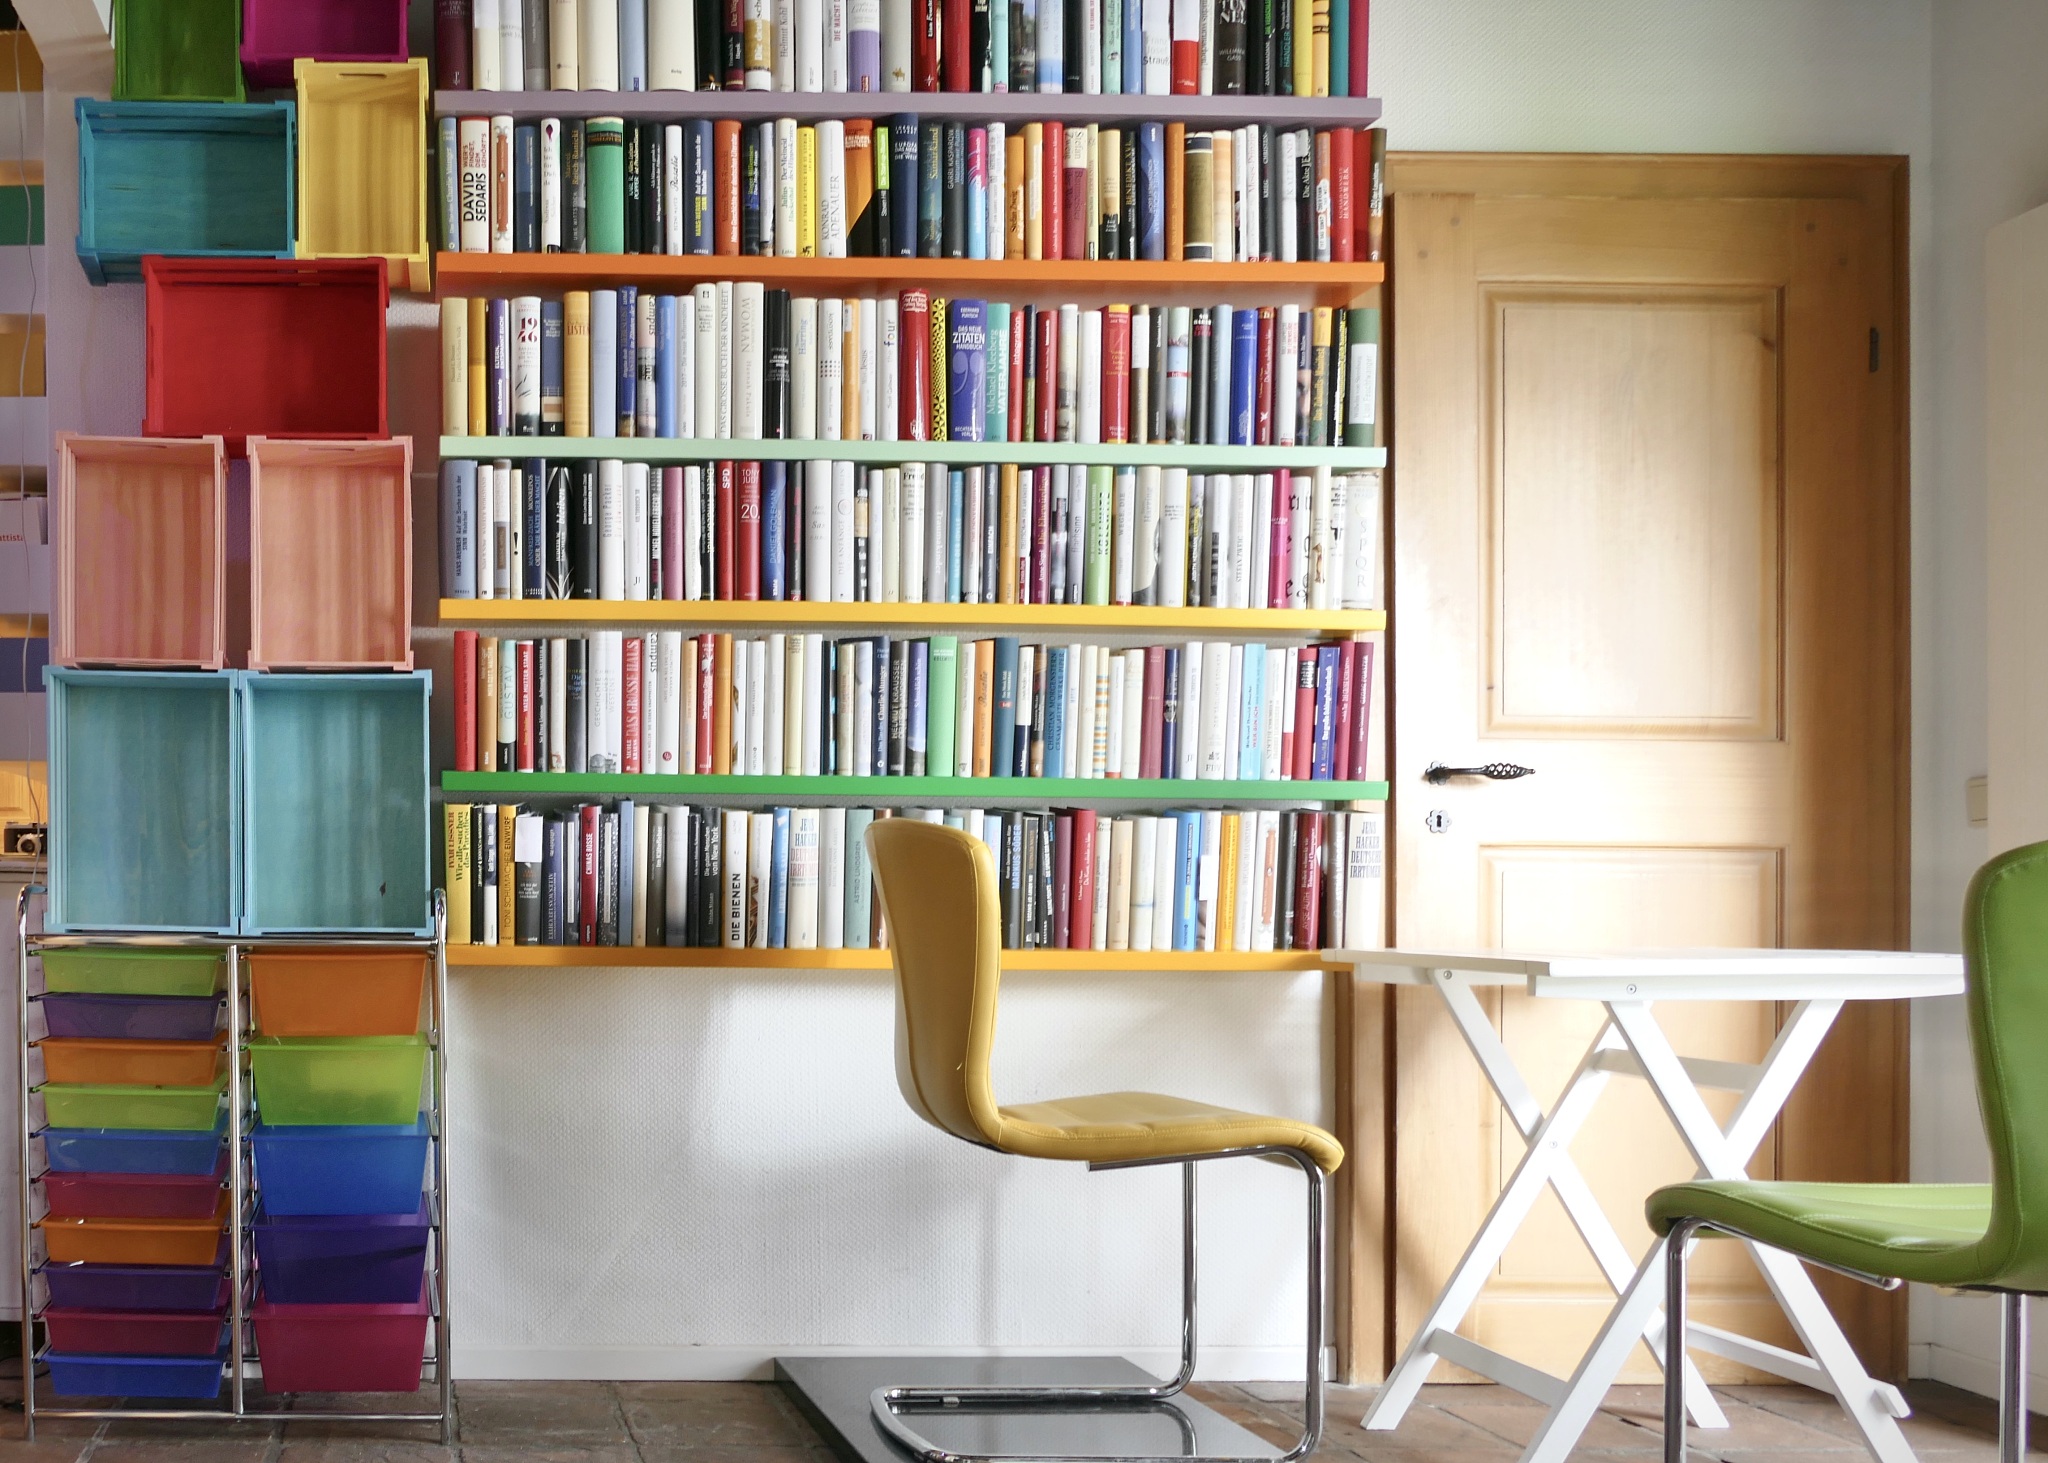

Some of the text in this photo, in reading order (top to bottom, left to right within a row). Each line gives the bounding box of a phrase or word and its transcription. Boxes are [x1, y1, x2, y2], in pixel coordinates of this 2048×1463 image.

[781, 7, 789, 57] Helmut Kohl
[833, 4, 841, 41] DIE MACHT
[753, 43, 763, 60] Die
[570, 130, 580, 185] Reich-Ranicki
[780, 137, 788, 181] Der Meineid
[1063, 131, 1074, 159] Zweig
[1073, 130, 1085, 160] Stefan
[462, 172, 475, 221] DAVID
[476, 172, 487, 221] SEDARIS
[730, 132, 738, 243] Meine Geschichte der deutschen Literatur
[1125, 141, 1133, 206] BENEDIKT XVI.
[1301, 167, 1310, 184] Akte
[1302, 185, 1310, 199] Die
[821, 199, 831, 241] KONRAD
[830, 174, 841, 239] ADENAUER
[645, 296, 656, 336] campus
[680, 303, 688, 340] Reformation
[740, 297, 751, 353] WOMAN
[797, 319, 808, 355] Harring
[952, 332, 985, 344] ZITATEN
[1012, 316, 1021, 365] Integration
[719, 288, 730, 433] DAS GROSSE BUCH DER KINDHEIT
[860, 349, 868, 371] Jesus
[986, 329, 999, 414] Michael Kleeberg
[997, 328, 1008, 414] VATERJAHRE
[722, 468, 730, 489] SPD
[902, 472, 925, 482] Freud
[527, 473, 535, 567] MANFRED ZACH MONREPOS
[533, 474, 542, 567] ODER DIE KÄLTE DER MACHT
[556, 487, 566, 525] bleiben
[602, 483, 614, 538] George Packer
[769, 489, 778, 564] DANIEL GOLEMAN
[932, 510, 944, 575] Traumakinder
[1234, 534, 1244, 583] STEFAN ZWEIG
[504, 664, 514, 720] GUSTAV
[594, 676, 602, 728] GESCHICHTE
[608, 677, 616, 714] WESTENS
[626, 639, 639, 737] DAS GROSSE HAUS
[878, 664, 888, 693] Munger
[890, 659, 901, 739] HELMUT KRAUSSER
[1047, 652, 1058, 751] CHRISTIAN MORGENSTERN
[1055, 652, 1065, 751] GESAMMELTE WERKE PIPER
[877, 694, 886, 721] Charlie
[448, 811, 456, 847] LISSNER
[455, 810, 465, 881] Wir alle suchen
[585, 832, 593, 852] BOSSE
[711, 826, 719, 844] York
[1355, 835, 1381, 850] HACKER
[503, 815, 512, 929] TONI SCHUMACHER EINWURF
[585, 852, 593, 875] CHINAS
[853, 840, 861, 904] ASTRID LINDGREN
[1011, 824, 1022, 889] MARKUS SÖDER
[1333, 831, 1344, 902] ASTRID LINDGREN
[731, 873, 741, 941] DIE BIENEN
